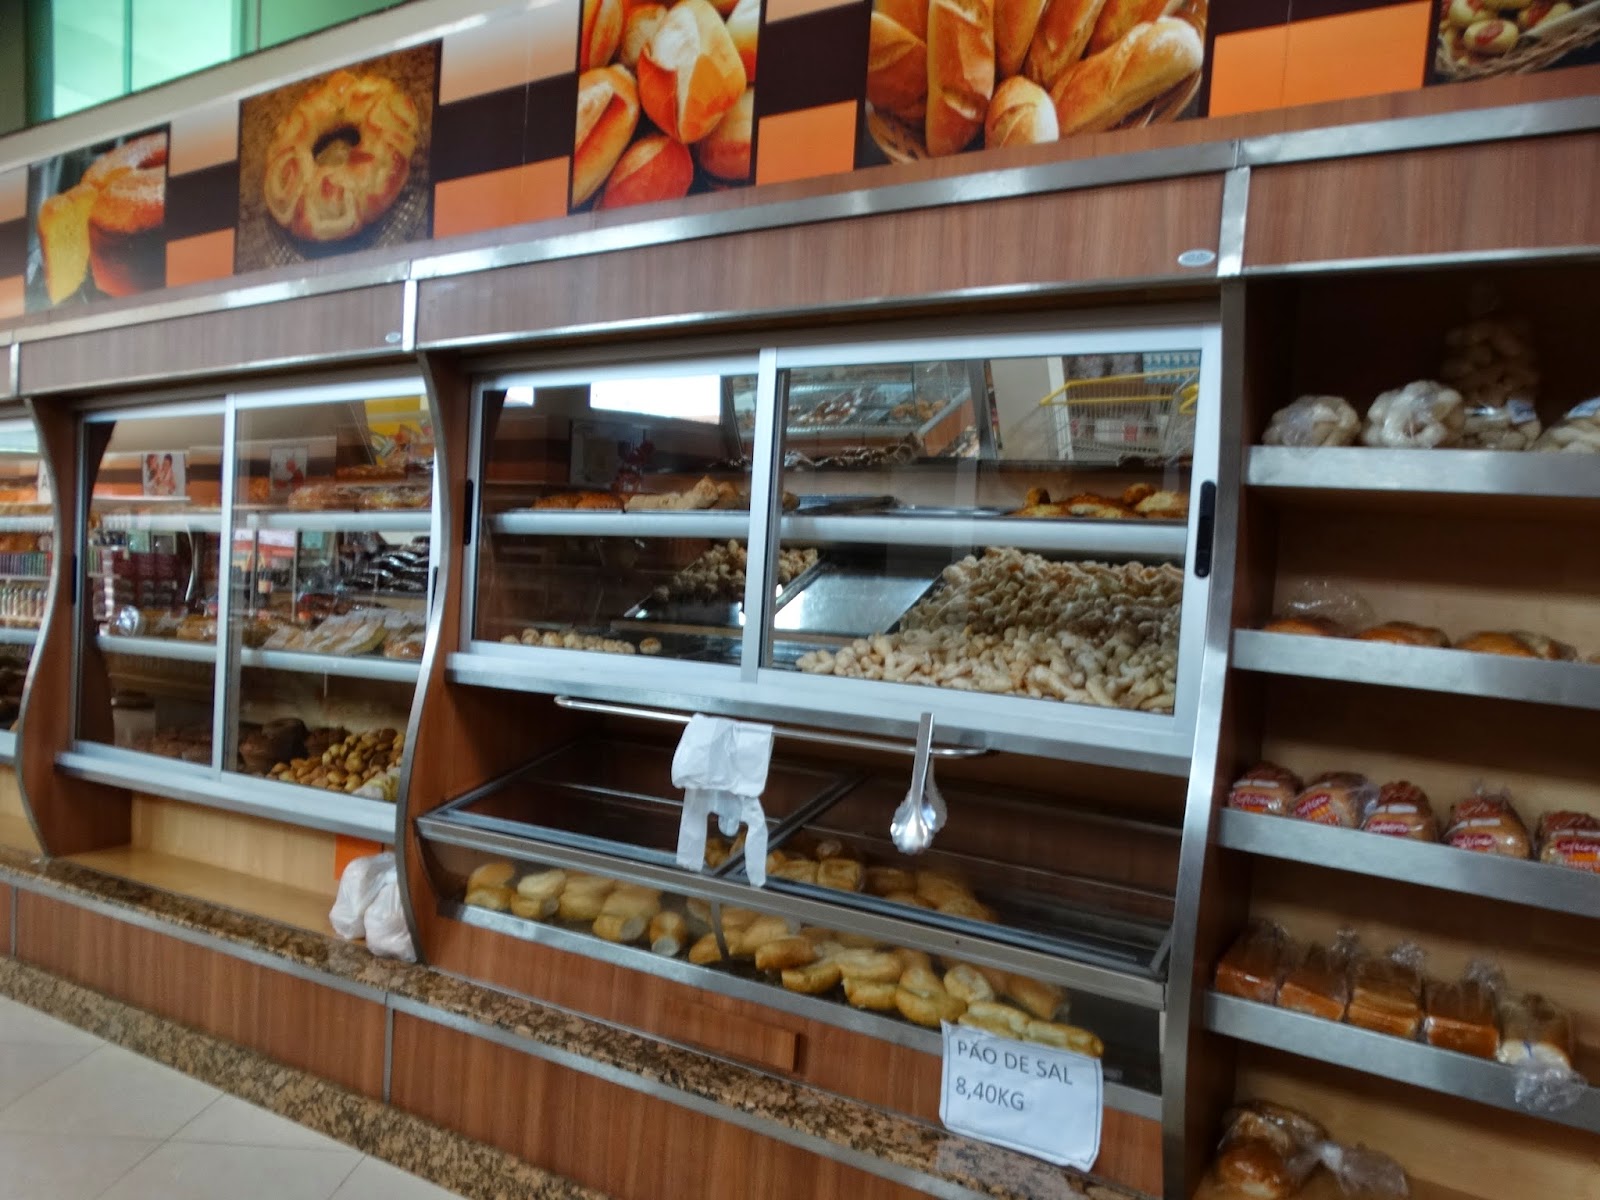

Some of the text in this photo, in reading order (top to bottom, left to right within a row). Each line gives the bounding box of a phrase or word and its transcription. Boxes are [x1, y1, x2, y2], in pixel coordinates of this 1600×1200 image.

[957, 1039, 1073, 1086] PÃO DE SAL
[956, 1076, 1025, 1111] 8,40KG
